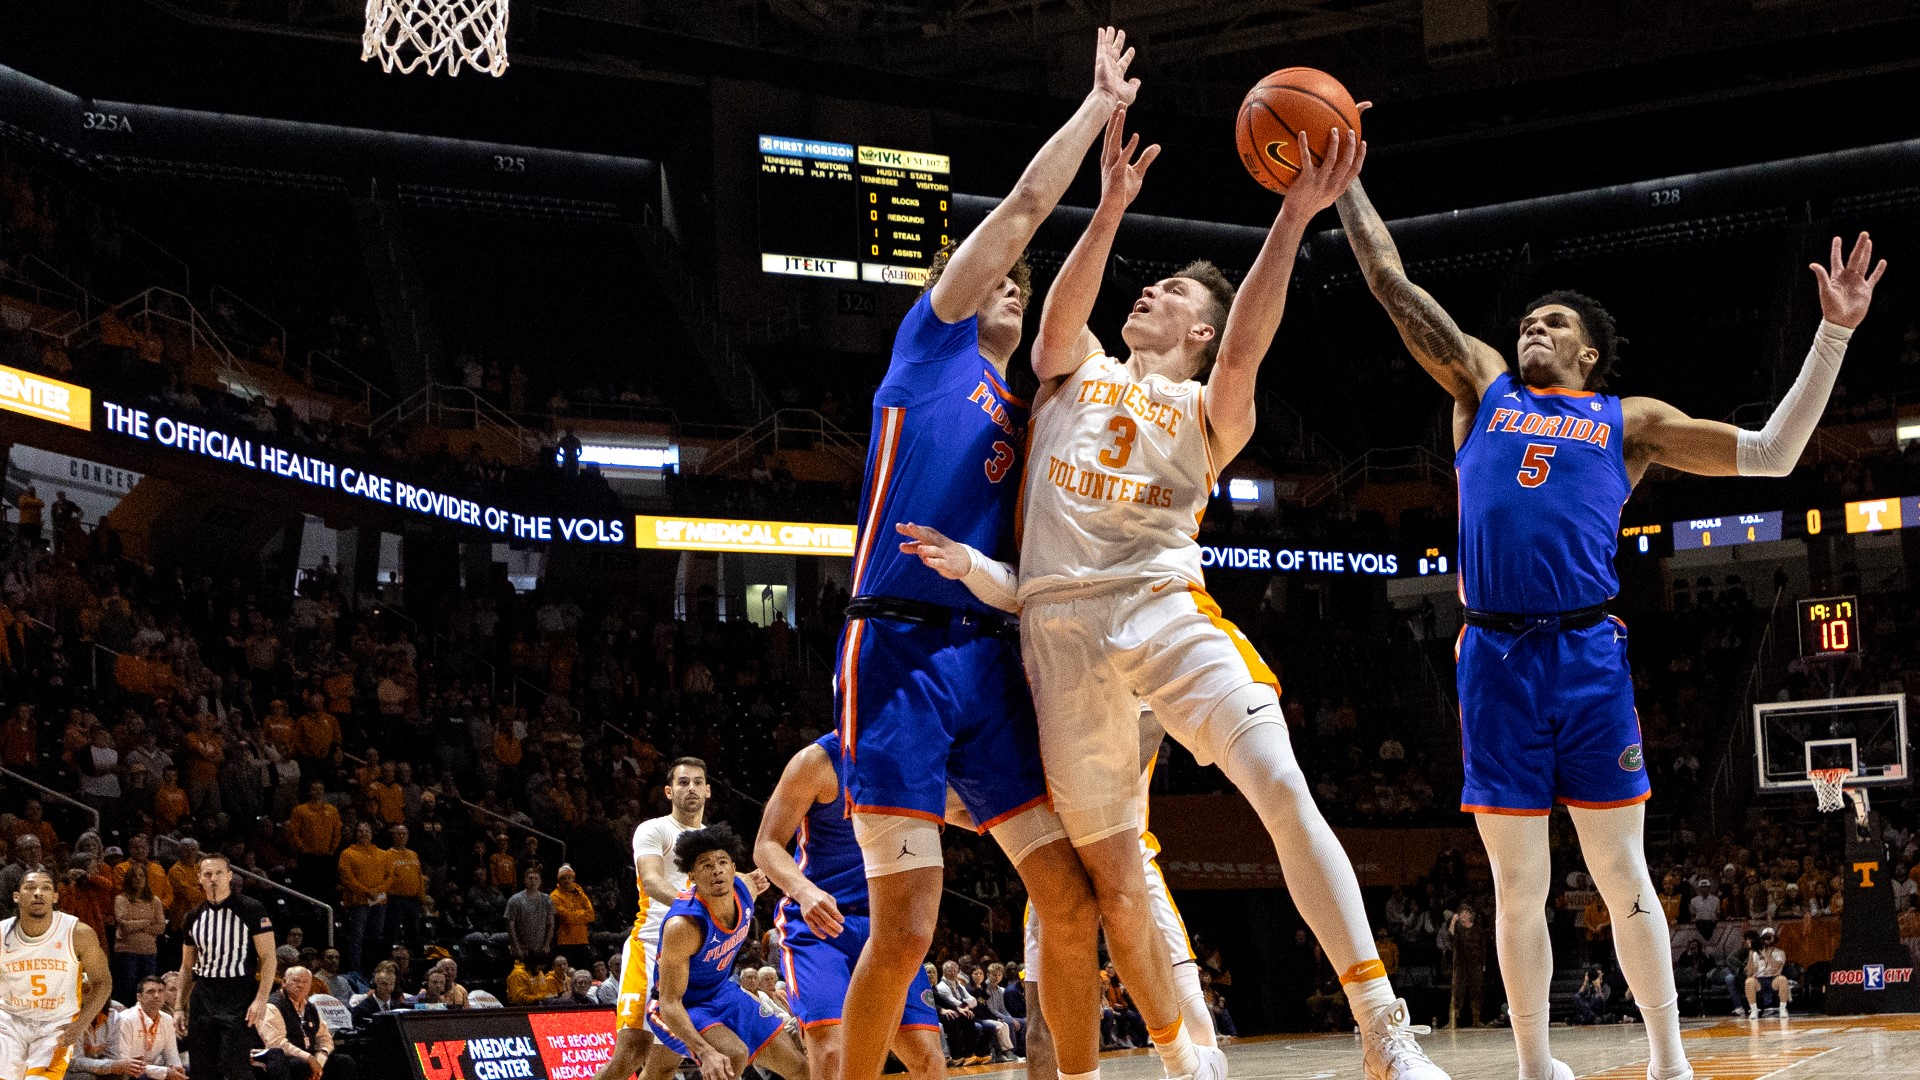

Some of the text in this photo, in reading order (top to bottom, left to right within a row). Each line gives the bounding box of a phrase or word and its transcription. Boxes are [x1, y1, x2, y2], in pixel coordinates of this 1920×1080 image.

[83, 112, 132, 133] 325A
[773, 139, 853, 158] FIRST HORIZON
[878, 151, 902, 165] IVK
[493, 156, 525, 173] 325
[762, 165, 777, 173] PLR
[789, 167, 804, 176] PTS
[764, 156, 803, 167] TENNESSEE
[814, 161, 849, 171] VISITORS
[811, 169, 825, 178] PLR
[837, 172, 853, 181] PTS
[860, 175, 899, 187] TENNESSEE
[877, 168, 933, 181] HUSTLE STATS
[916, 182, 950, 192] VISITORS
[870, 192, 947, 211] 0 BLOCKS 0
[1651, 188, 1680, 207] 328
[870, 209, 878, 221] 0
[887, 213, 925, 225] REBOUNDS
[893, 231, 921, 241] STEALS
[941, 234, 948, 246] 0
[871, 244, 922, 259] 0 ASSISTS
[784, 256, 837, 273] JTEKT
[1078, 379, 1182, 438] TENESSEE
[1486, 407, 1611, 449] FLORIDA
[1099, 415, 1137, 469] 3
[984, 441, 1015, 483] 3
[1516, 443, 1557, 488] 5
[103, 401, 624, 543] THE OFFICIAL HEALTH CARE PROVIDER OF THE VOLS
[1047, 455, 1173, 508] VOLUNTEERS
[1690, 518, 1722, 530] FOULS
[1807, 509, 1821, 535] 0
[1859, 501, 1887, 531] T
[686, 523, 776, 545] MEDICAL
[779, 526, 854, 547] CENTER
[1622, 524, 1661, 537] OFF REB
[1702, 527, 1755, 547] 0 4
[1427, 548, 1439, 556] FG
[1638, 535, 1648, 552] 0
[1277, 550, 1304, 570] OF
[1308, 551, 1345, 571] THE
[1348, 552, 1398, 574] VOLS
[1810, 602, 1851, 621] 19:17
[1822, 620, 1849, 649] 10
[1853, 861, 1878, 888] T
[5, 959, 68, 973] TENNESSEE
[30, 974, 48, 996] 5
[1830, 970, 1864, 985] FOOD
[1883, 968, 1913, 984] CITY
[620, 993, 641, 1016] T
[468, 1036, 536, 1060] MEDICAL
[547, 1032, 615, 1049] THE REGION'S
[561, 1048, 613, 1064] ACADEMIC
[475, 1058, 534, 1080] CENTER
[551, 1066, 594, 1080] MEDICAL
